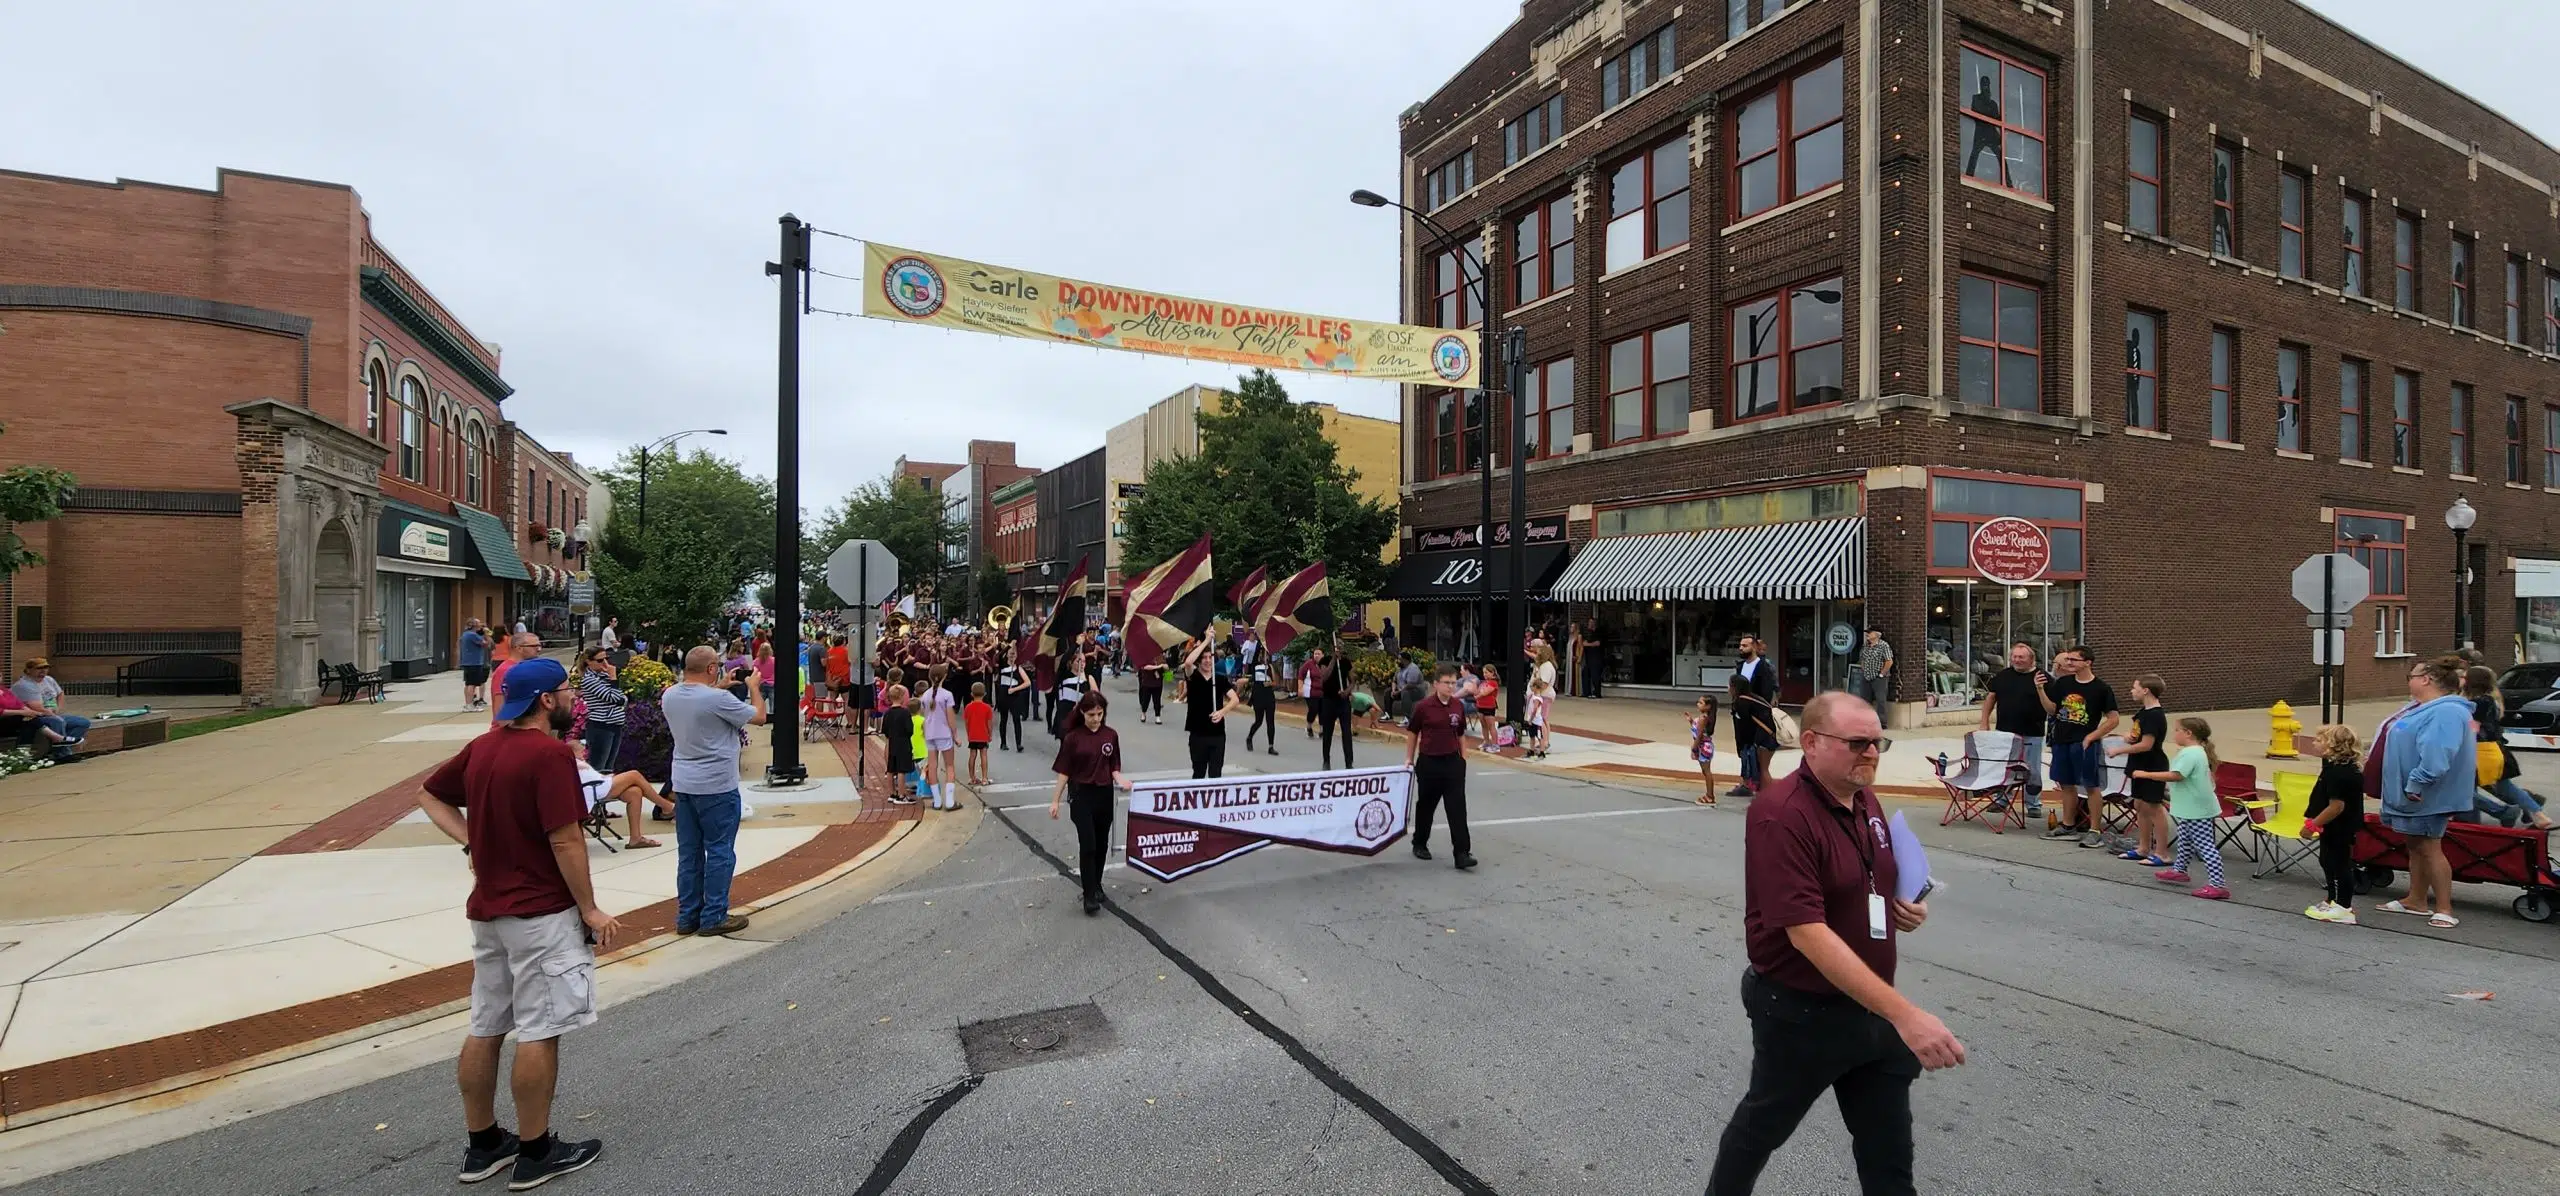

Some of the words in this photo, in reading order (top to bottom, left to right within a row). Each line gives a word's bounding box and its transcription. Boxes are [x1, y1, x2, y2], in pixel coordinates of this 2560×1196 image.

[1551, 10, 1606, 62] DALE
[969, 270, 1039, 300] Carle
[963, 296, 995, 310] Hayley
[997, 302, 1028, 315] Siefert
[963, 305, 986, 320] kw
[1057, 281, 1214, 325] DOWNTOWN
[1221, 307, 1352, 340] DANVILLE'S
[1121, 310, 1224, 342] Artisan
[1233, 323, 1300, 355] Table
[1387, 330, 1415, 344] OSF
[1980, 530, 2008, 545] Sweet
[2008, 531, 2041, 551] Repeats
[1153, 786, 1261, 812] DANVILLE
[1266, 782, 1316, 804] HIGH
[1319, 776, 1390, 799] SCHOOL
[1219, 810, 1256, 823] BAND
[1260, 808, 1277, 819] OF
[1278, 803, 1334, 817] VIKINGS
[1137, 831, 1199, 846] DANVILLE
[1142, 843, 1194, 858] ILLINOIS
